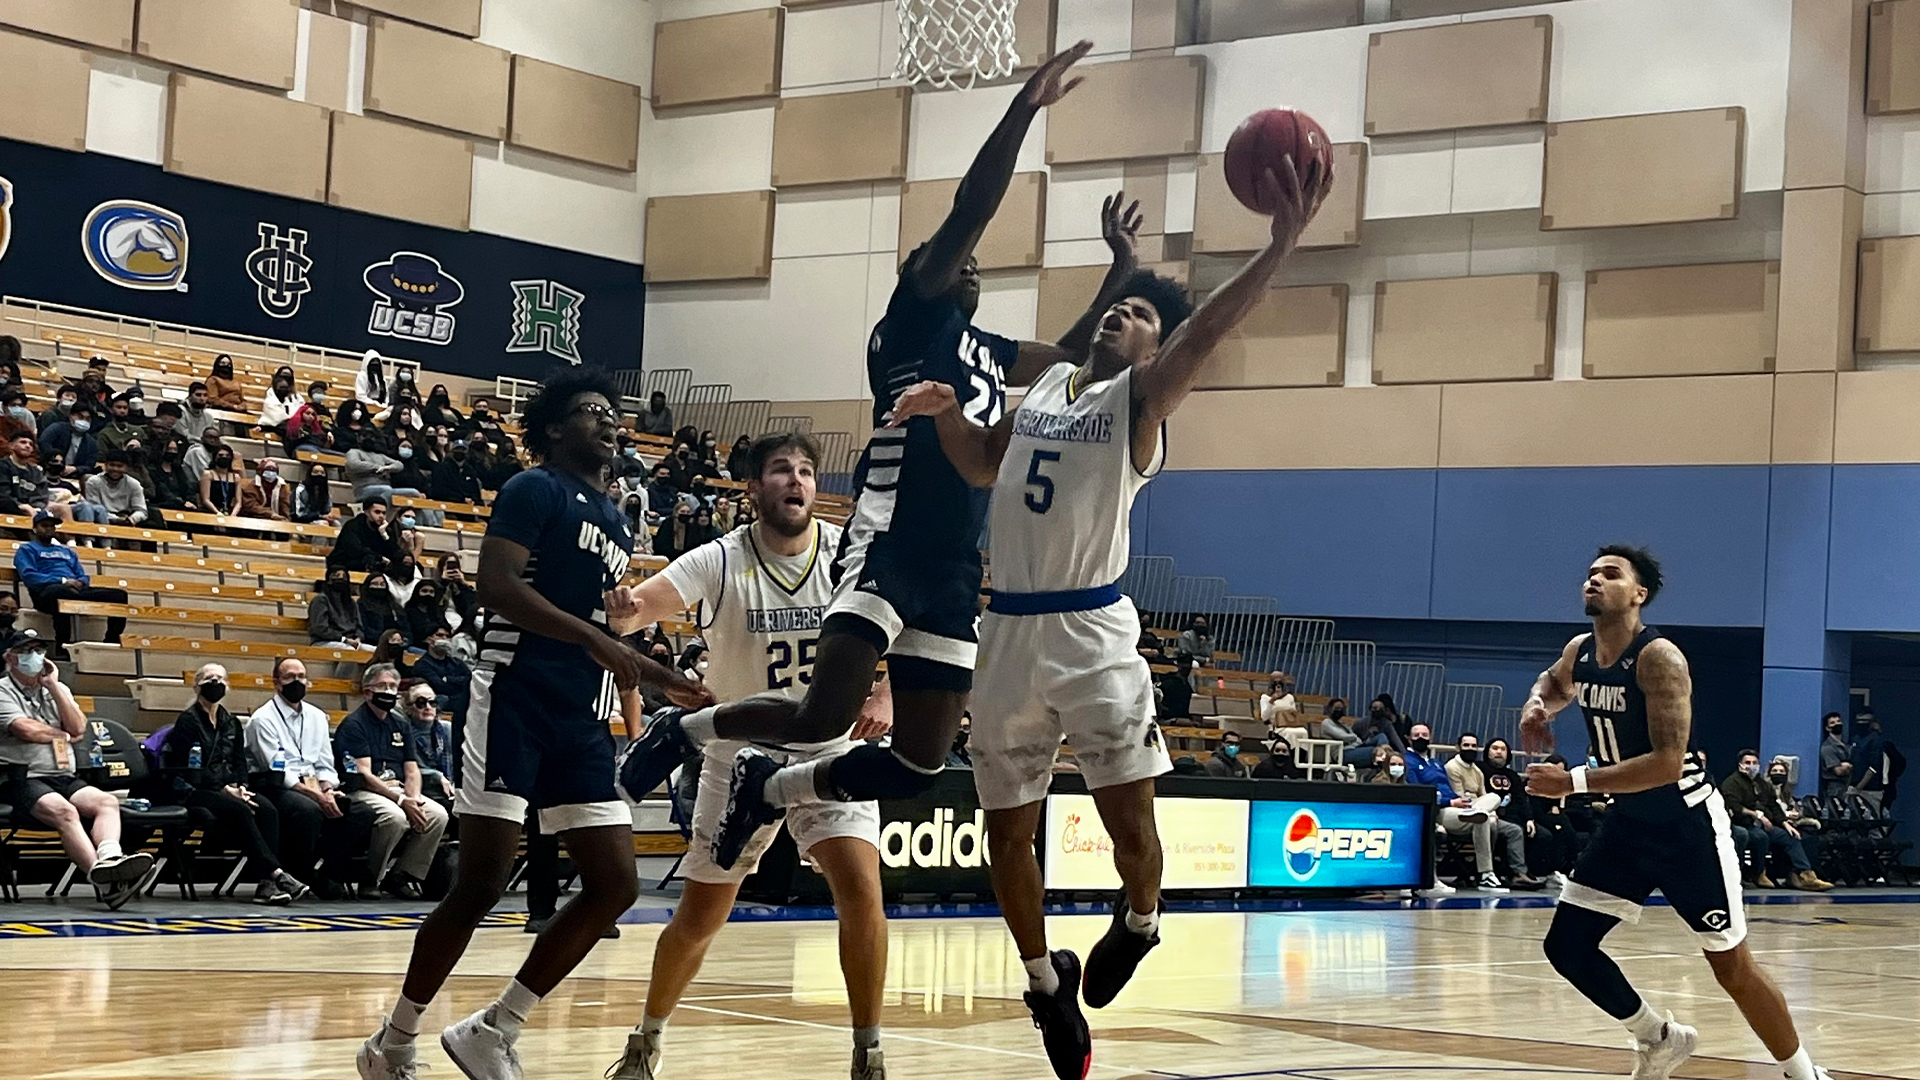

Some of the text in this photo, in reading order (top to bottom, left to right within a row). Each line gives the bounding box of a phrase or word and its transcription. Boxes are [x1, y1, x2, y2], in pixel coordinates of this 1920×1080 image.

[371, 304, 453, 343] UCSB
[1024, 449, 1061, 515] 5
[766, 638, 819, 690] 25
[1589, 684, 1627, 713] DAVIS
[1592, 715, 1621, 764] 11
[879, 807, 993, 869] adid
[1183, 843, 1216, 854] Riverside
[1314, 827, 1393, 860] PEPSI
